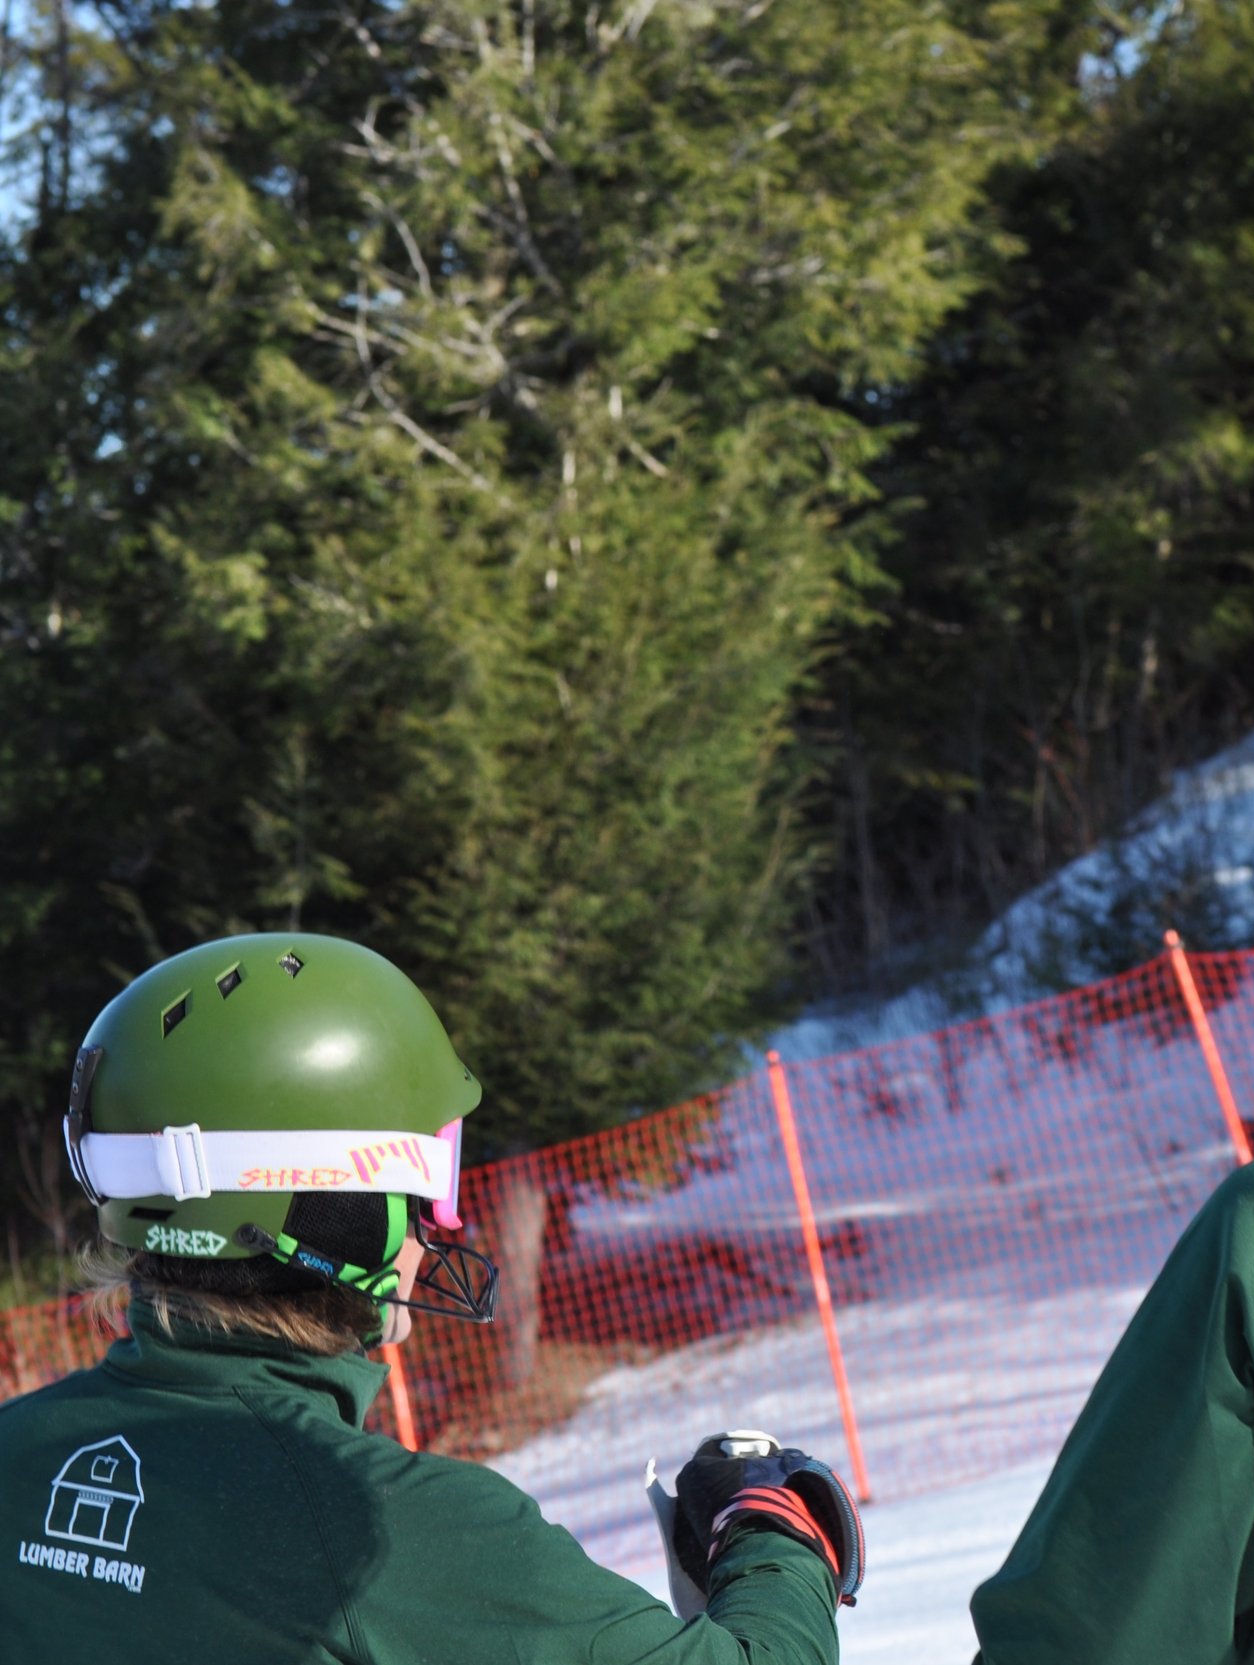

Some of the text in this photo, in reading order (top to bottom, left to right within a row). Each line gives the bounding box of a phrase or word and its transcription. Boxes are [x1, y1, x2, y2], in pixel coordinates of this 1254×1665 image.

[238, 1167, 352, 1188] SHRED
[145, 1224, 228, 1257] SHRED
[19, 1541, 145, 1589] LUMBER BARN
